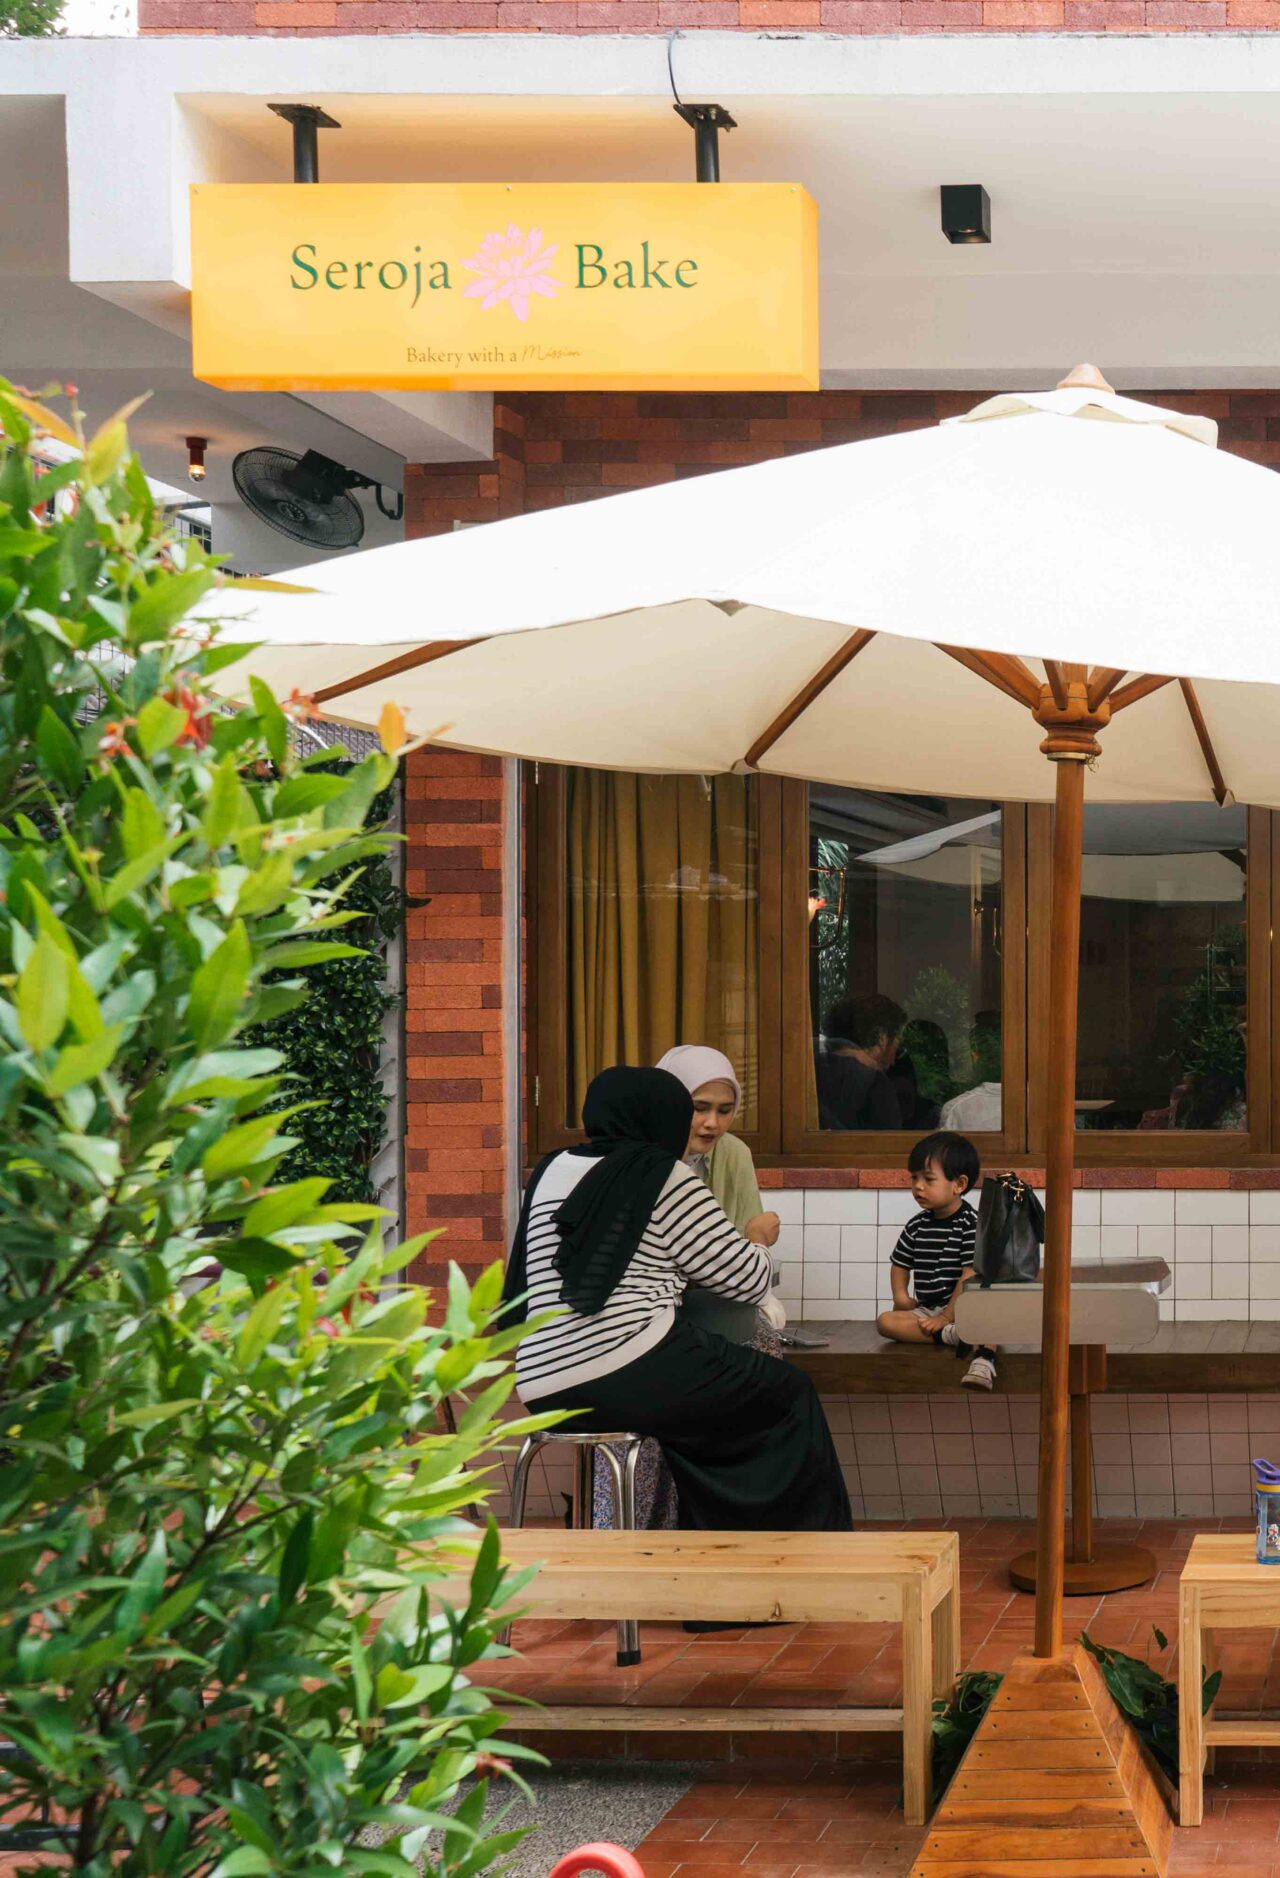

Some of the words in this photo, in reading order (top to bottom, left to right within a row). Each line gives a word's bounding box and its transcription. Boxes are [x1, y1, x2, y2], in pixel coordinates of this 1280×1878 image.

[290, 243, 452, 309] Seroja
[574, 241, 699, 290] Bake
[407, 347, 463, 368] Bakery
[469, 346, 504, 363] with
[509, 354, 517, 363] a
